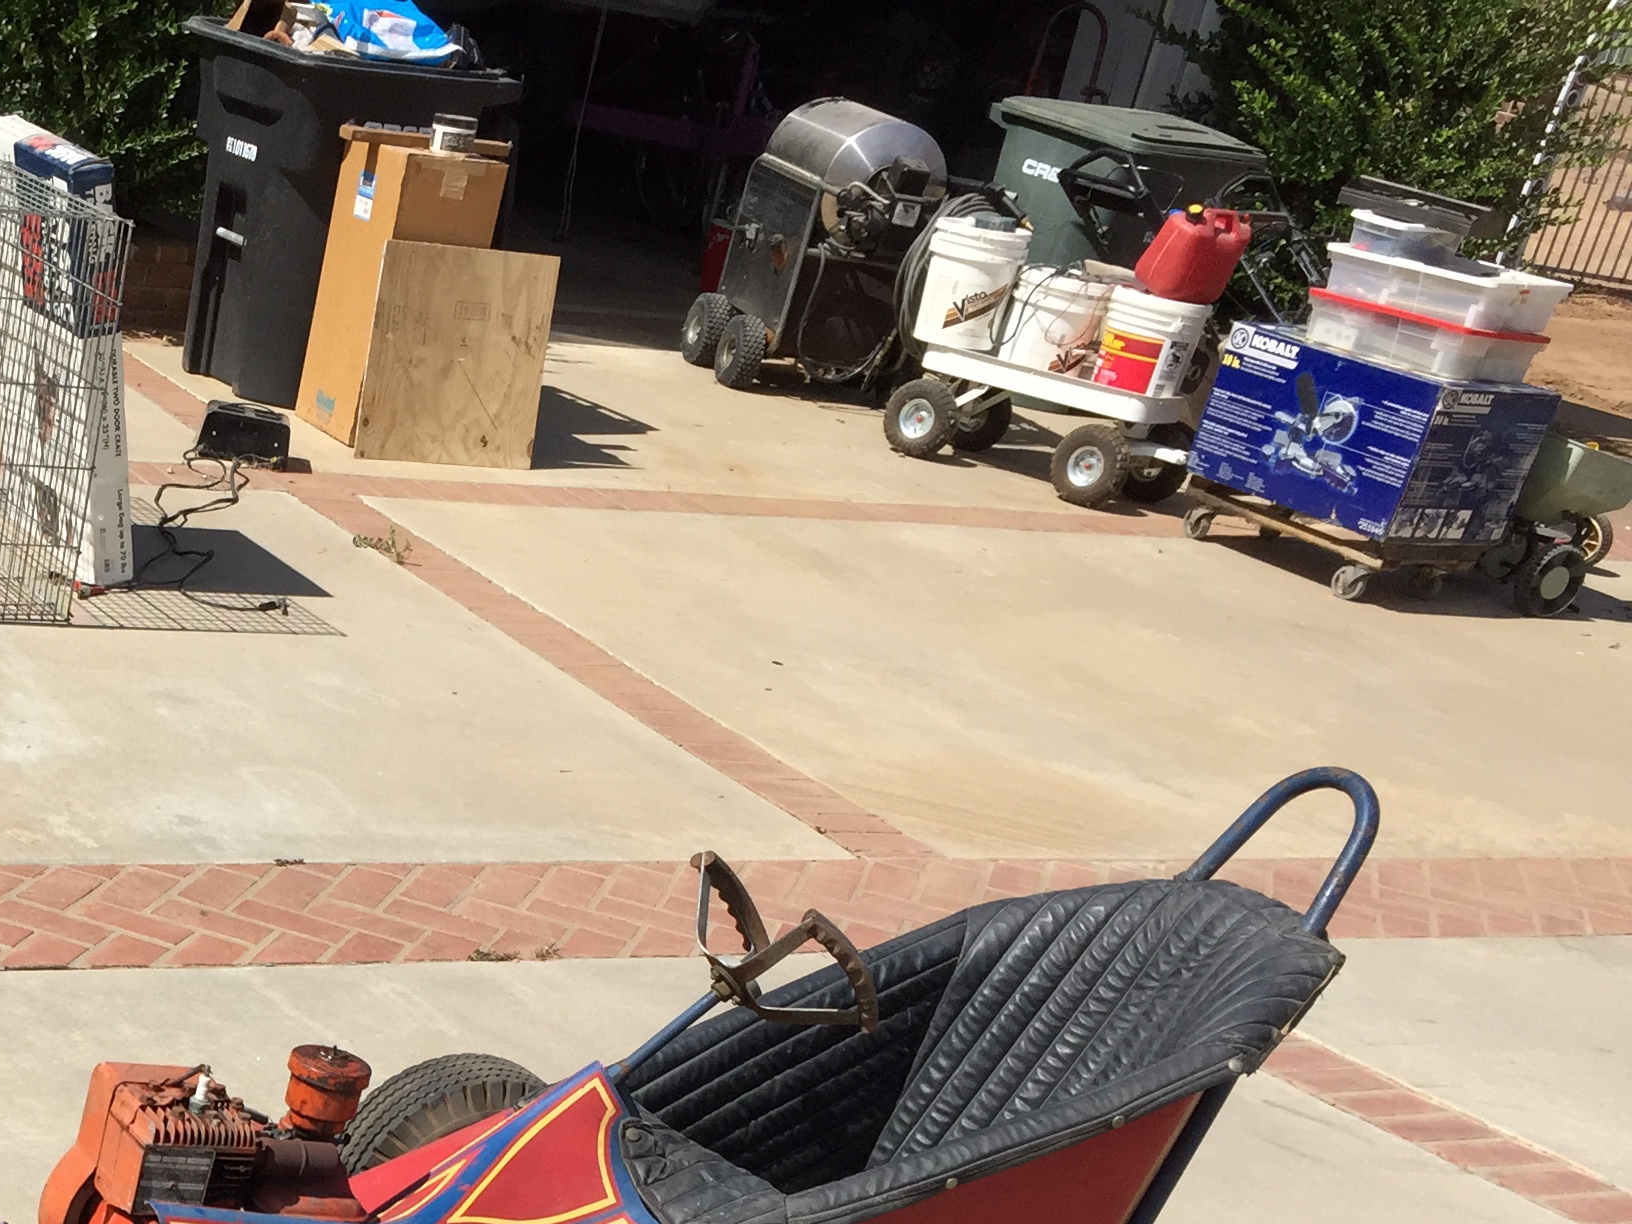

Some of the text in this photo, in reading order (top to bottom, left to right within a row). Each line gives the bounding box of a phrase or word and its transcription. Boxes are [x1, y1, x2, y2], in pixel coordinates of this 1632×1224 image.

[952, 291, 988, 321] Vista
[1251, 334, 1300, 359] KOBALT
[112, 387, 120, 406] TWO
[113, 409, 121, 432] DOOR
[114, 435, 122, 457] CRATE
